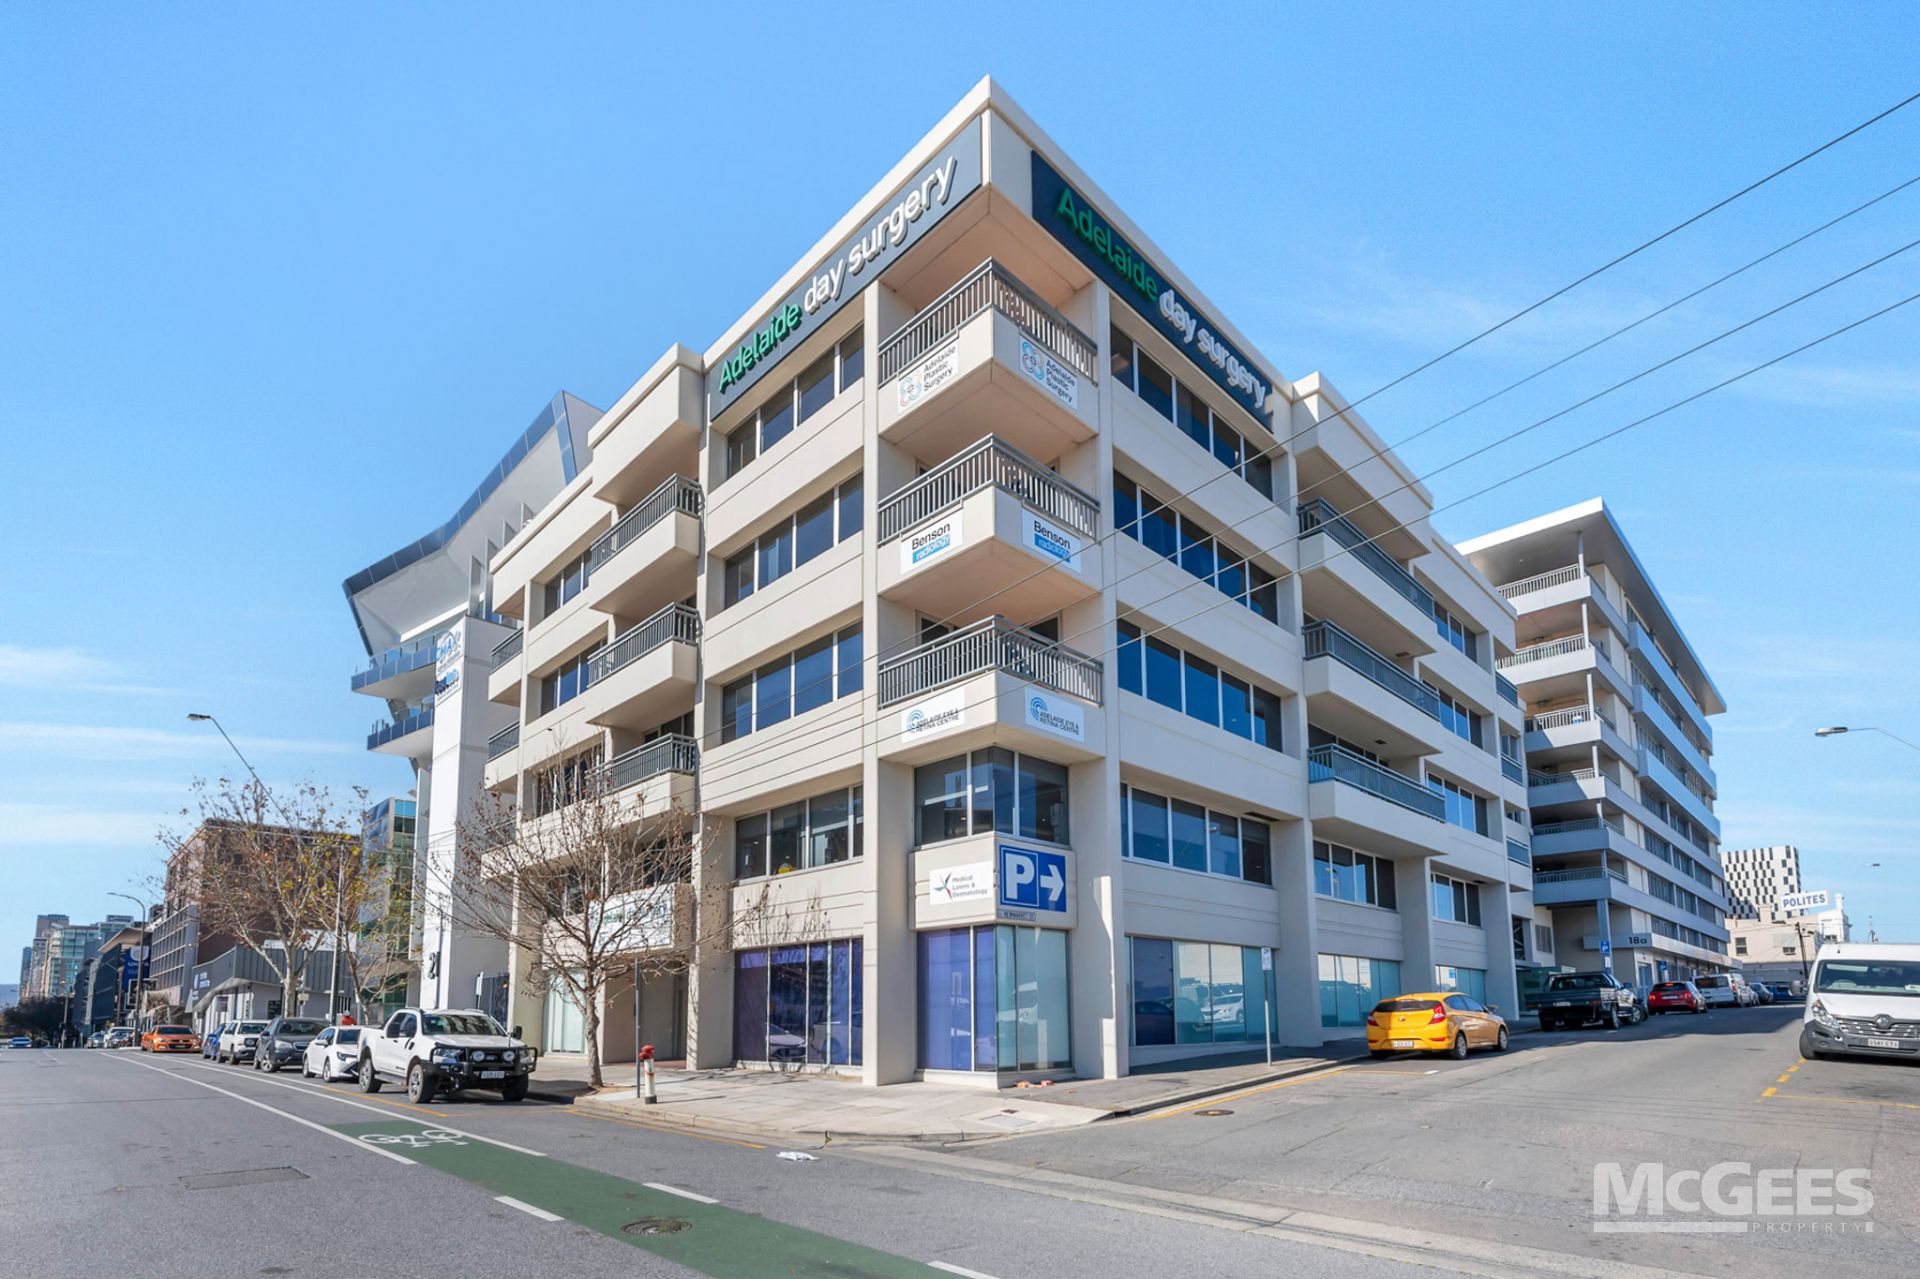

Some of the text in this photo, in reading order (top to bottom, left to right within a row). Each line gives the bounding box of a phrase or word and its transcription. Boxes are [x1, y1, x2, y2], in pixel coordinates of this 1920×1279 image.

[719, 156, 957, 394] Adelaide day surgery
[1056, 187, 1266, 408] Adelaide day surgery
[924, 346, 956, 373] Adelaide
[924, 361, 949, 382] Plastic
[924, 367, 953, 391] Surgery
[1046, 359, 1075, 386] Adelaide
[1046, 368, 1069, 391] Plastic
[1046, 377, 1072, 403] Surgery
[912, 523, 951, 550] Benson
[1034, 520, 1071, 550] Benson
[937, 714, 959, 726] CENTRE
[1040, 711, 1064, 725] ADELAIDE
[952, 875, 973, 883] Medical
[952, 883, 970, 891] Lasers
[1005, 853, 1035, 900] P
[952, 889, 988, 898] Dermatology
[1783, 894, 1825, 907] POLITES
